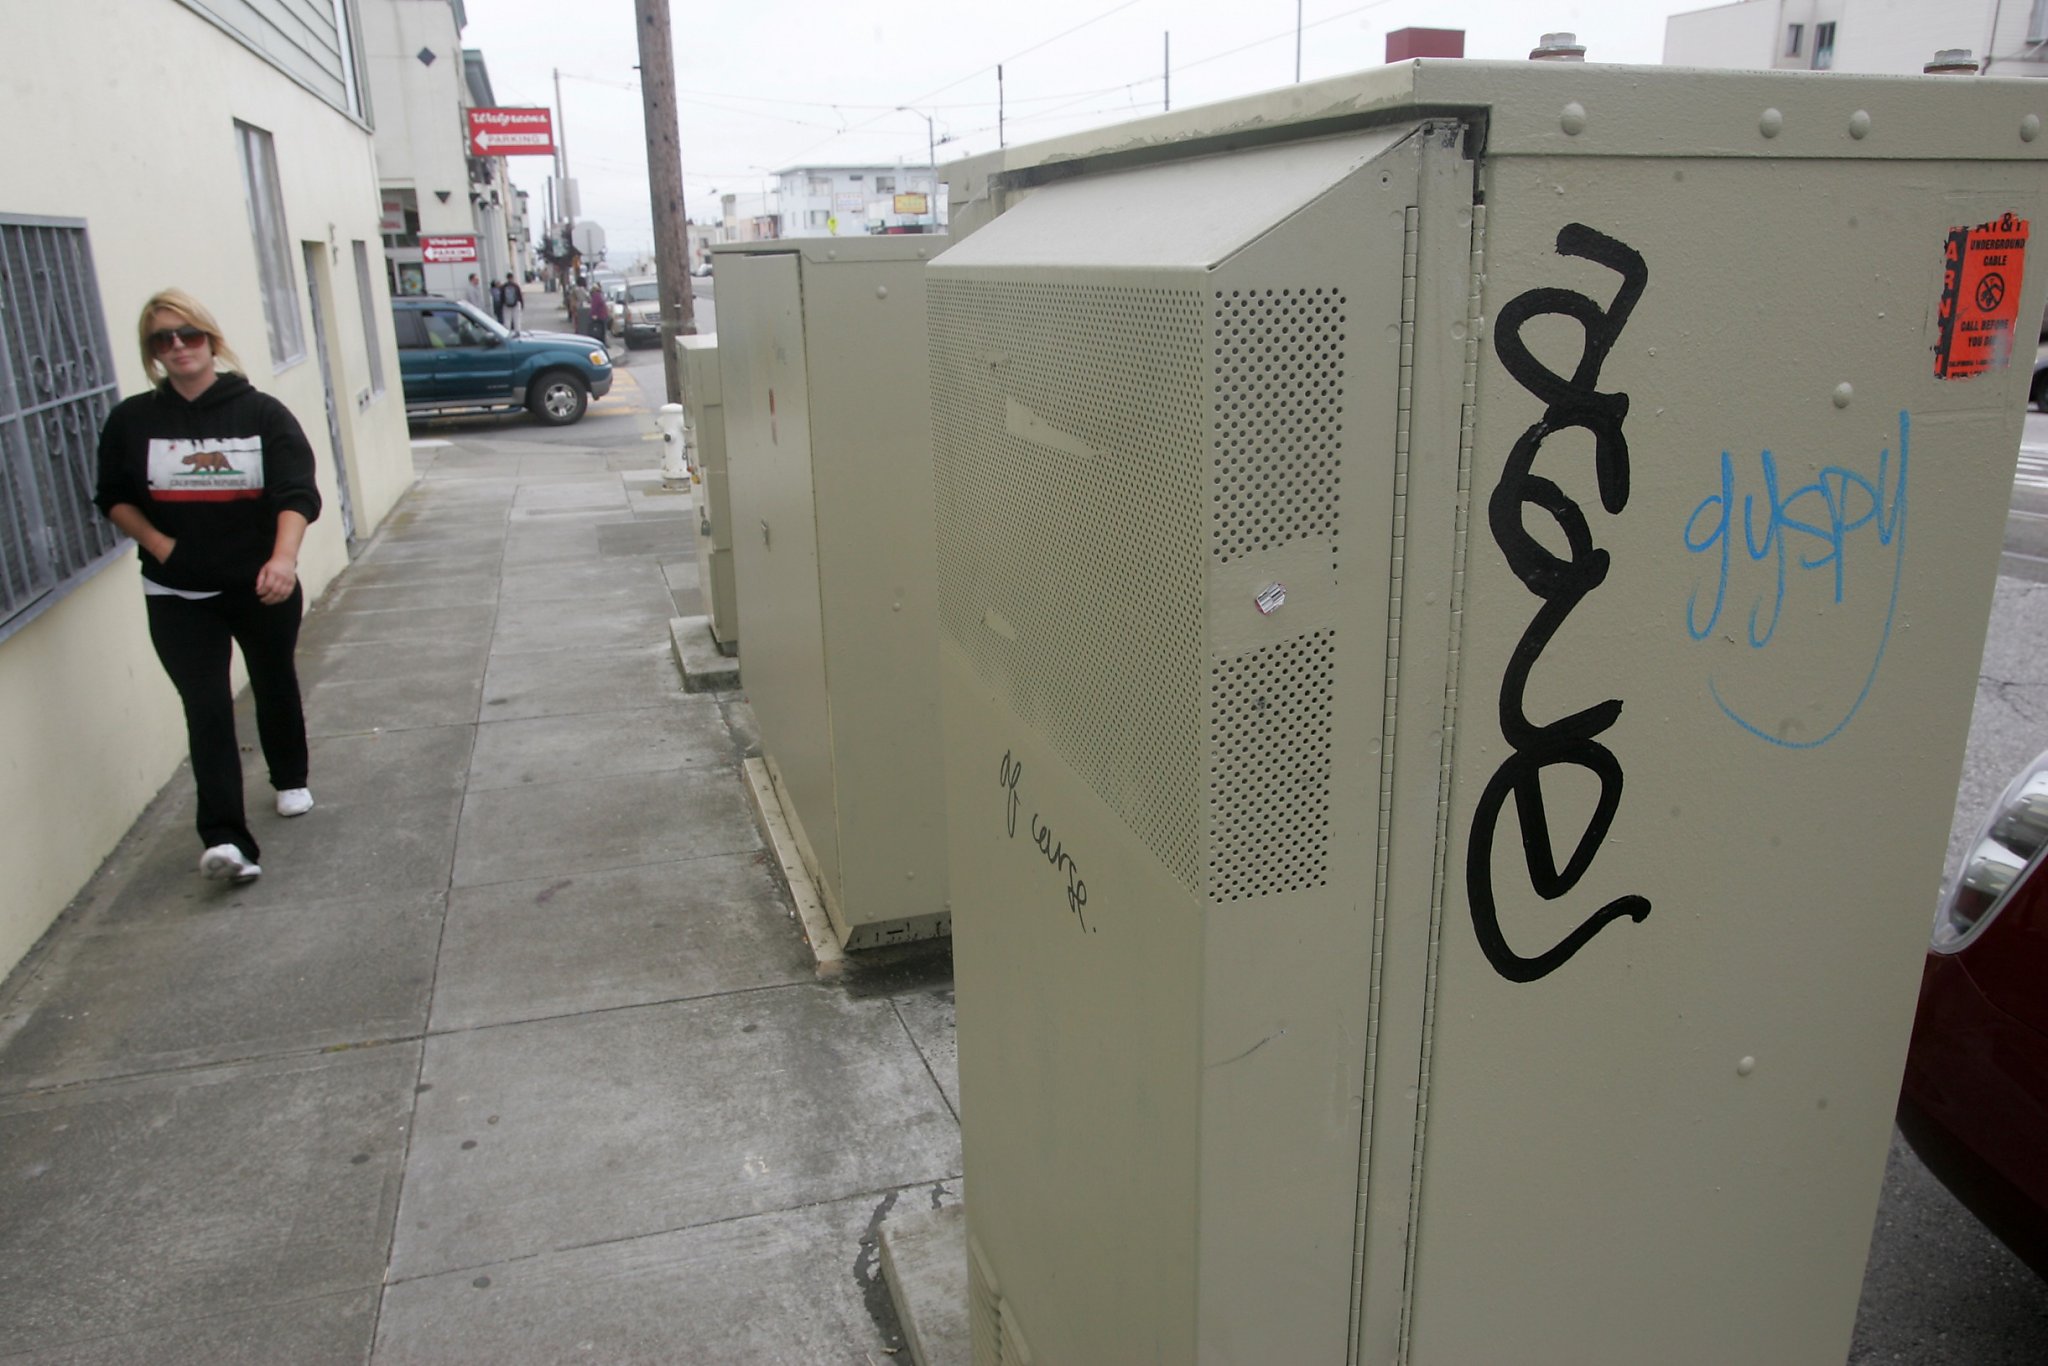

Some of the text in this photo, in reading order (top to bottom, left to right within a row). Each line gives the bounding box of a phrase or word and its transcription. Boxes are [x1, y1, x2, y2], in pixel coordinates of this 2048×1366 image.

[488, 134, 540, 145] PARKING
[1971, 239, 2025, 251] UNDERGROUND
[433, 249, 473, 257] PARKING
[1983, 255, 2008, 267] CABLE
[1961, 319, 2009, 332] CALL BEFORE
[1968, 336, 1983, 347] YOU
[170, 480, 248, 488] CALIFORNIA REPUBLIC
